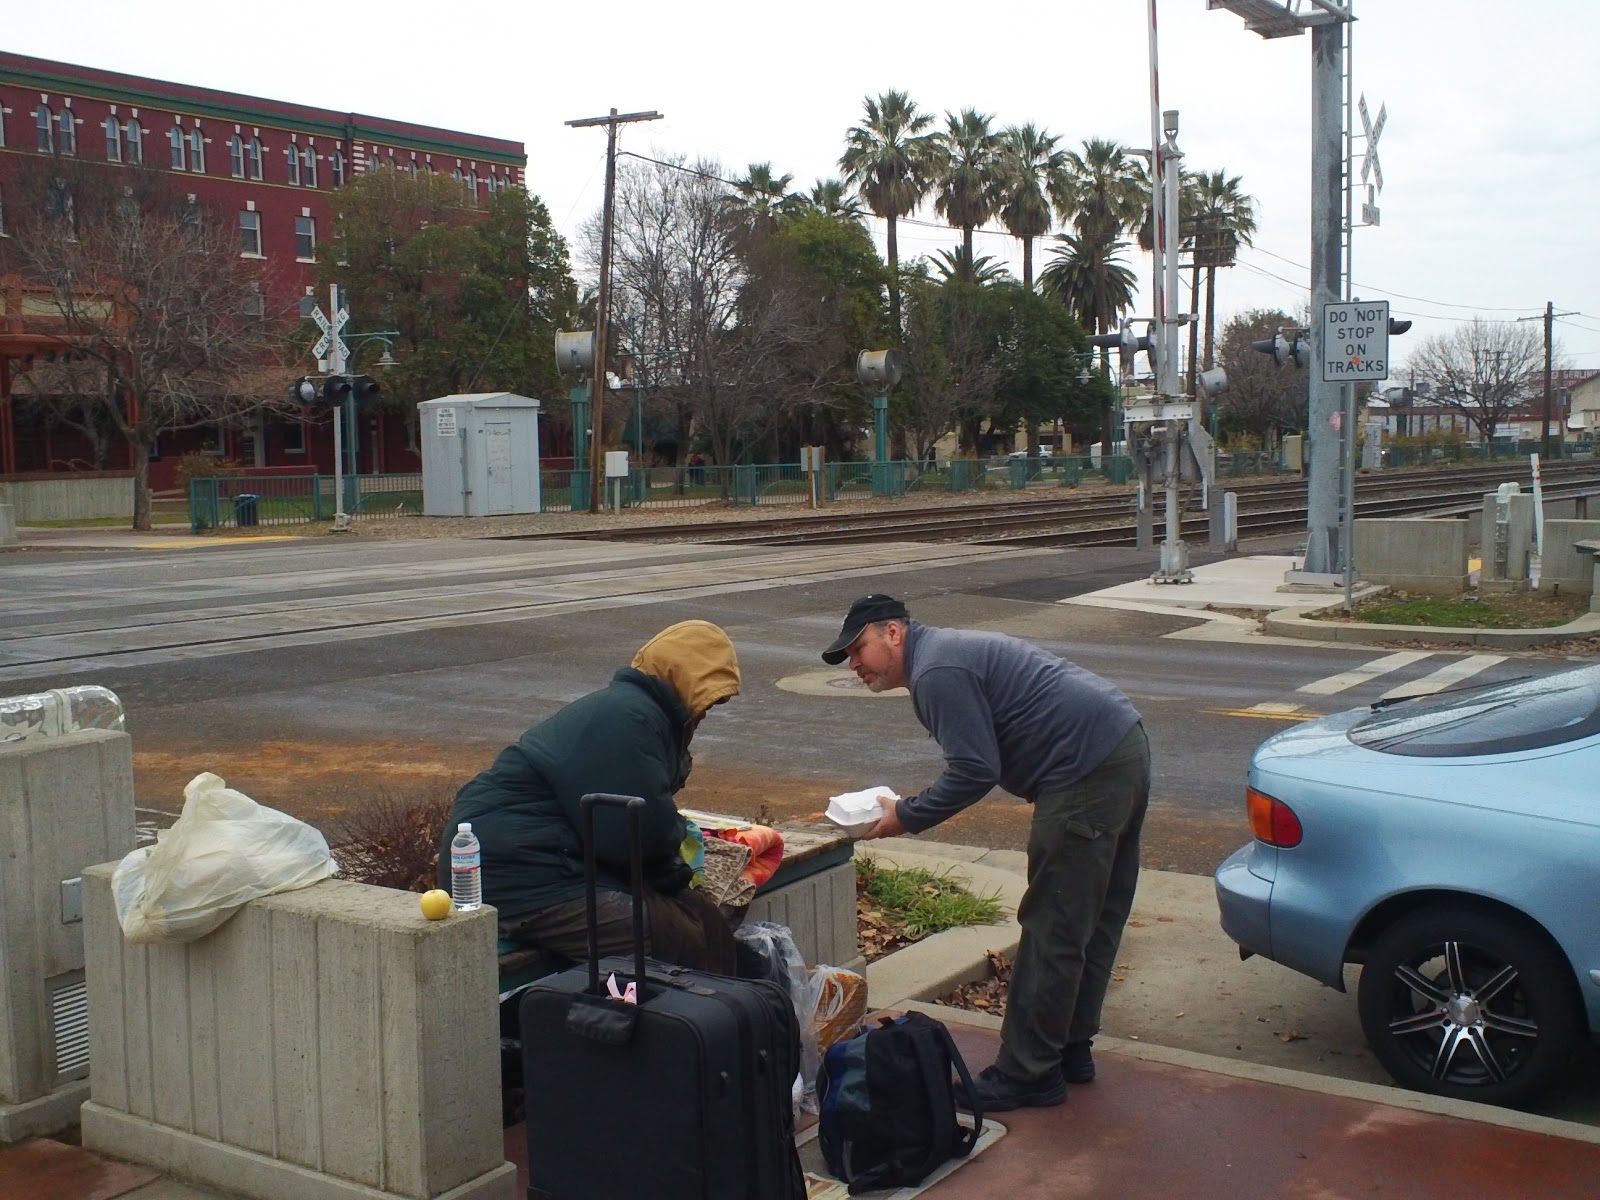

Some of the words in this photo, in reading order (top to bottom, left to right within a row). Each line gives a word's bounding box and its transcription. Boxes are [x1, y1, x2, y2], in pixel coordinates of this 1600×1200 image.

[1329, 311, 1348, 323] DO
[1357, 309, 1384, 322] NOT
[1337, 327, 1375, 339] STOP
[1345, 344, 1366, 356] ON
[1327, 360, 1384, 373] TRACKS
